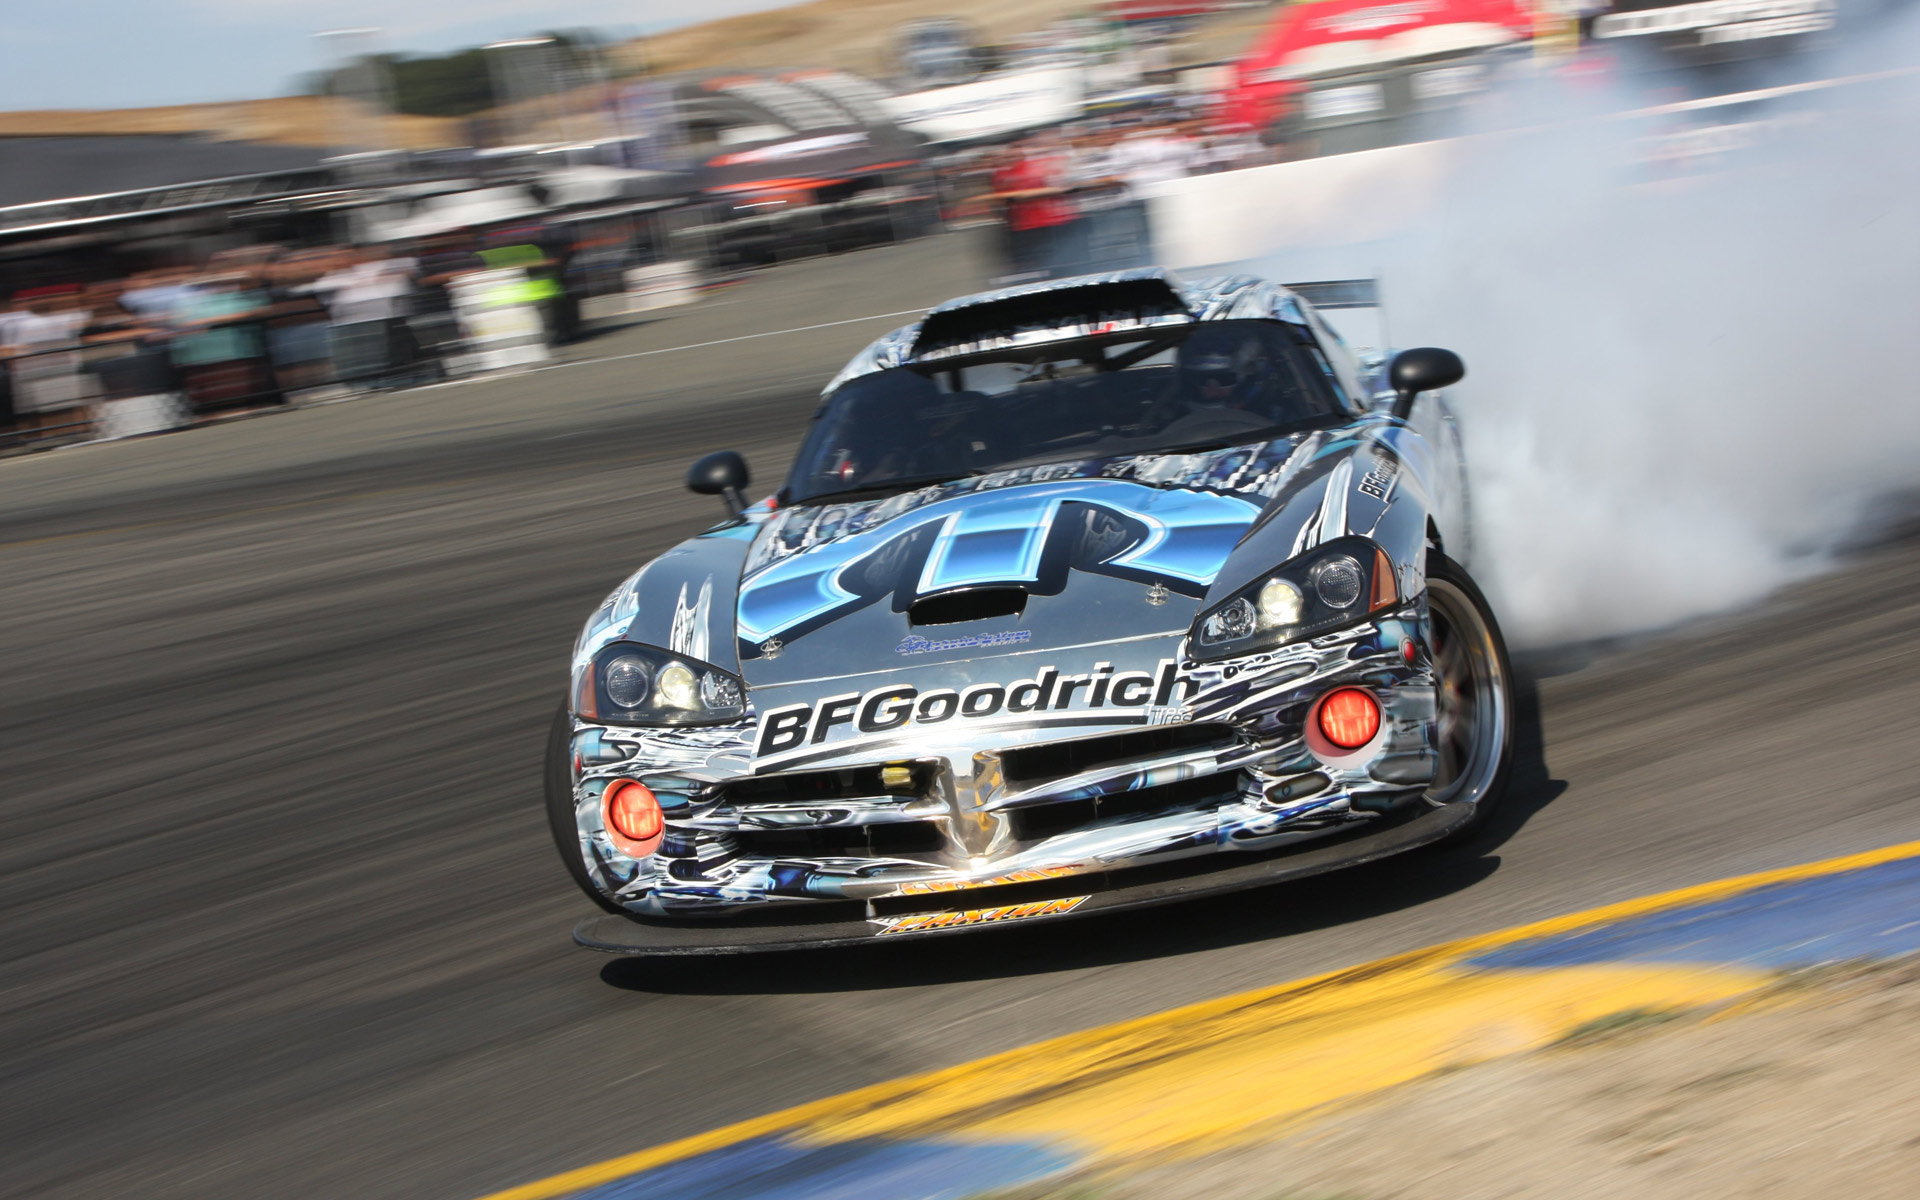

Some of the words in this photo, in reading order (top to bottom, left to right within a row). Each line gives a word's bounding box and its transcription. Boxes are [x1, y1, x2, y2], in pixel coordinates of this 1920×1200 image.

[1358, 455, 1397, 500] BFGood
[751, 658, 1200, 758] BFGoodrich
[1149, 704, 1193, 725] Tires
[887, 896, 1087, 931] PAXTON
